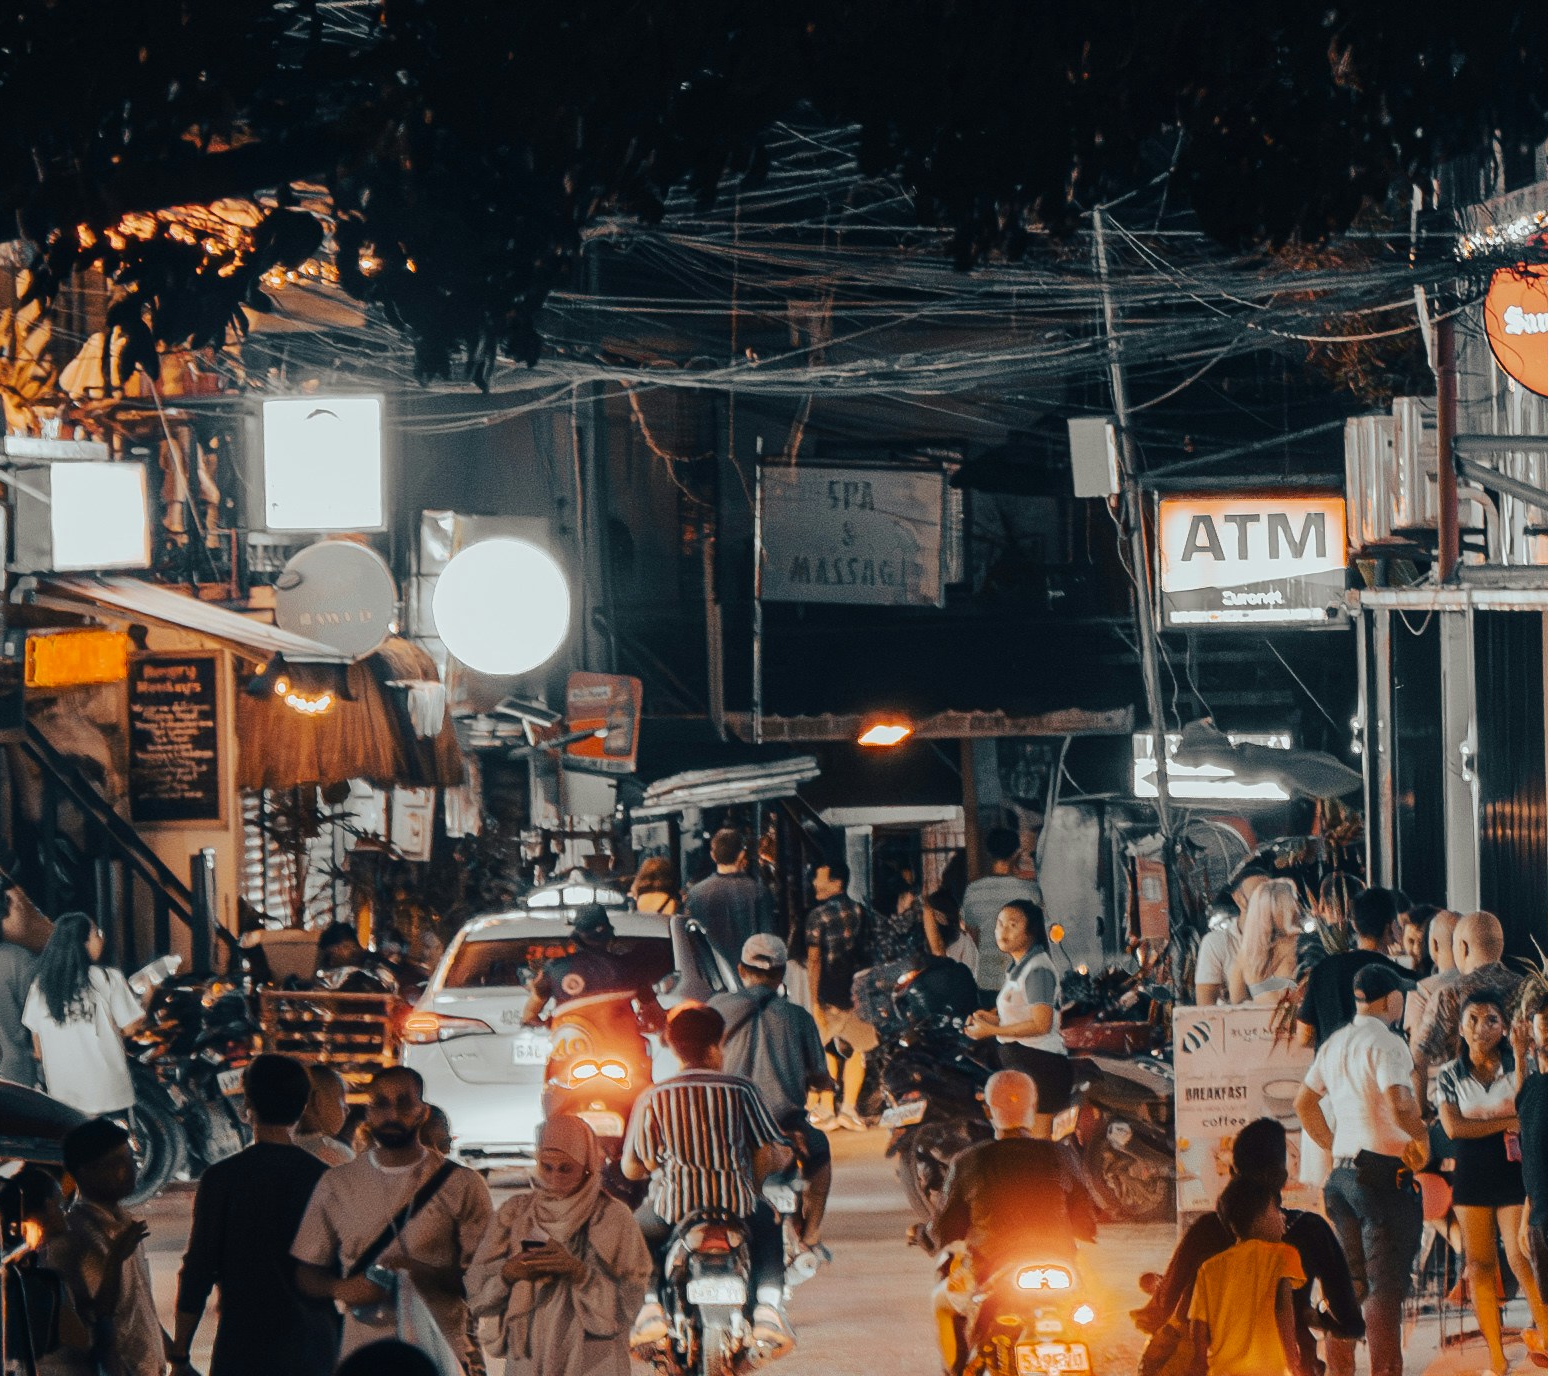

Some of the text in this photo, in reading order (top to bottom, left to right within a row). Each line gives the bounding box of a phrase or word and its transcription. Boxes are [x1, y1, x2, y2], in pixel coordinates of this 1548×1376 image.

[827, 480, 875, 511] SPA
[1181, 512, 1327, 561] ATM
[1185, 1085, 1248, 1102] BREAKFAST
[1203, 1115, 1247, 1128] coffee
